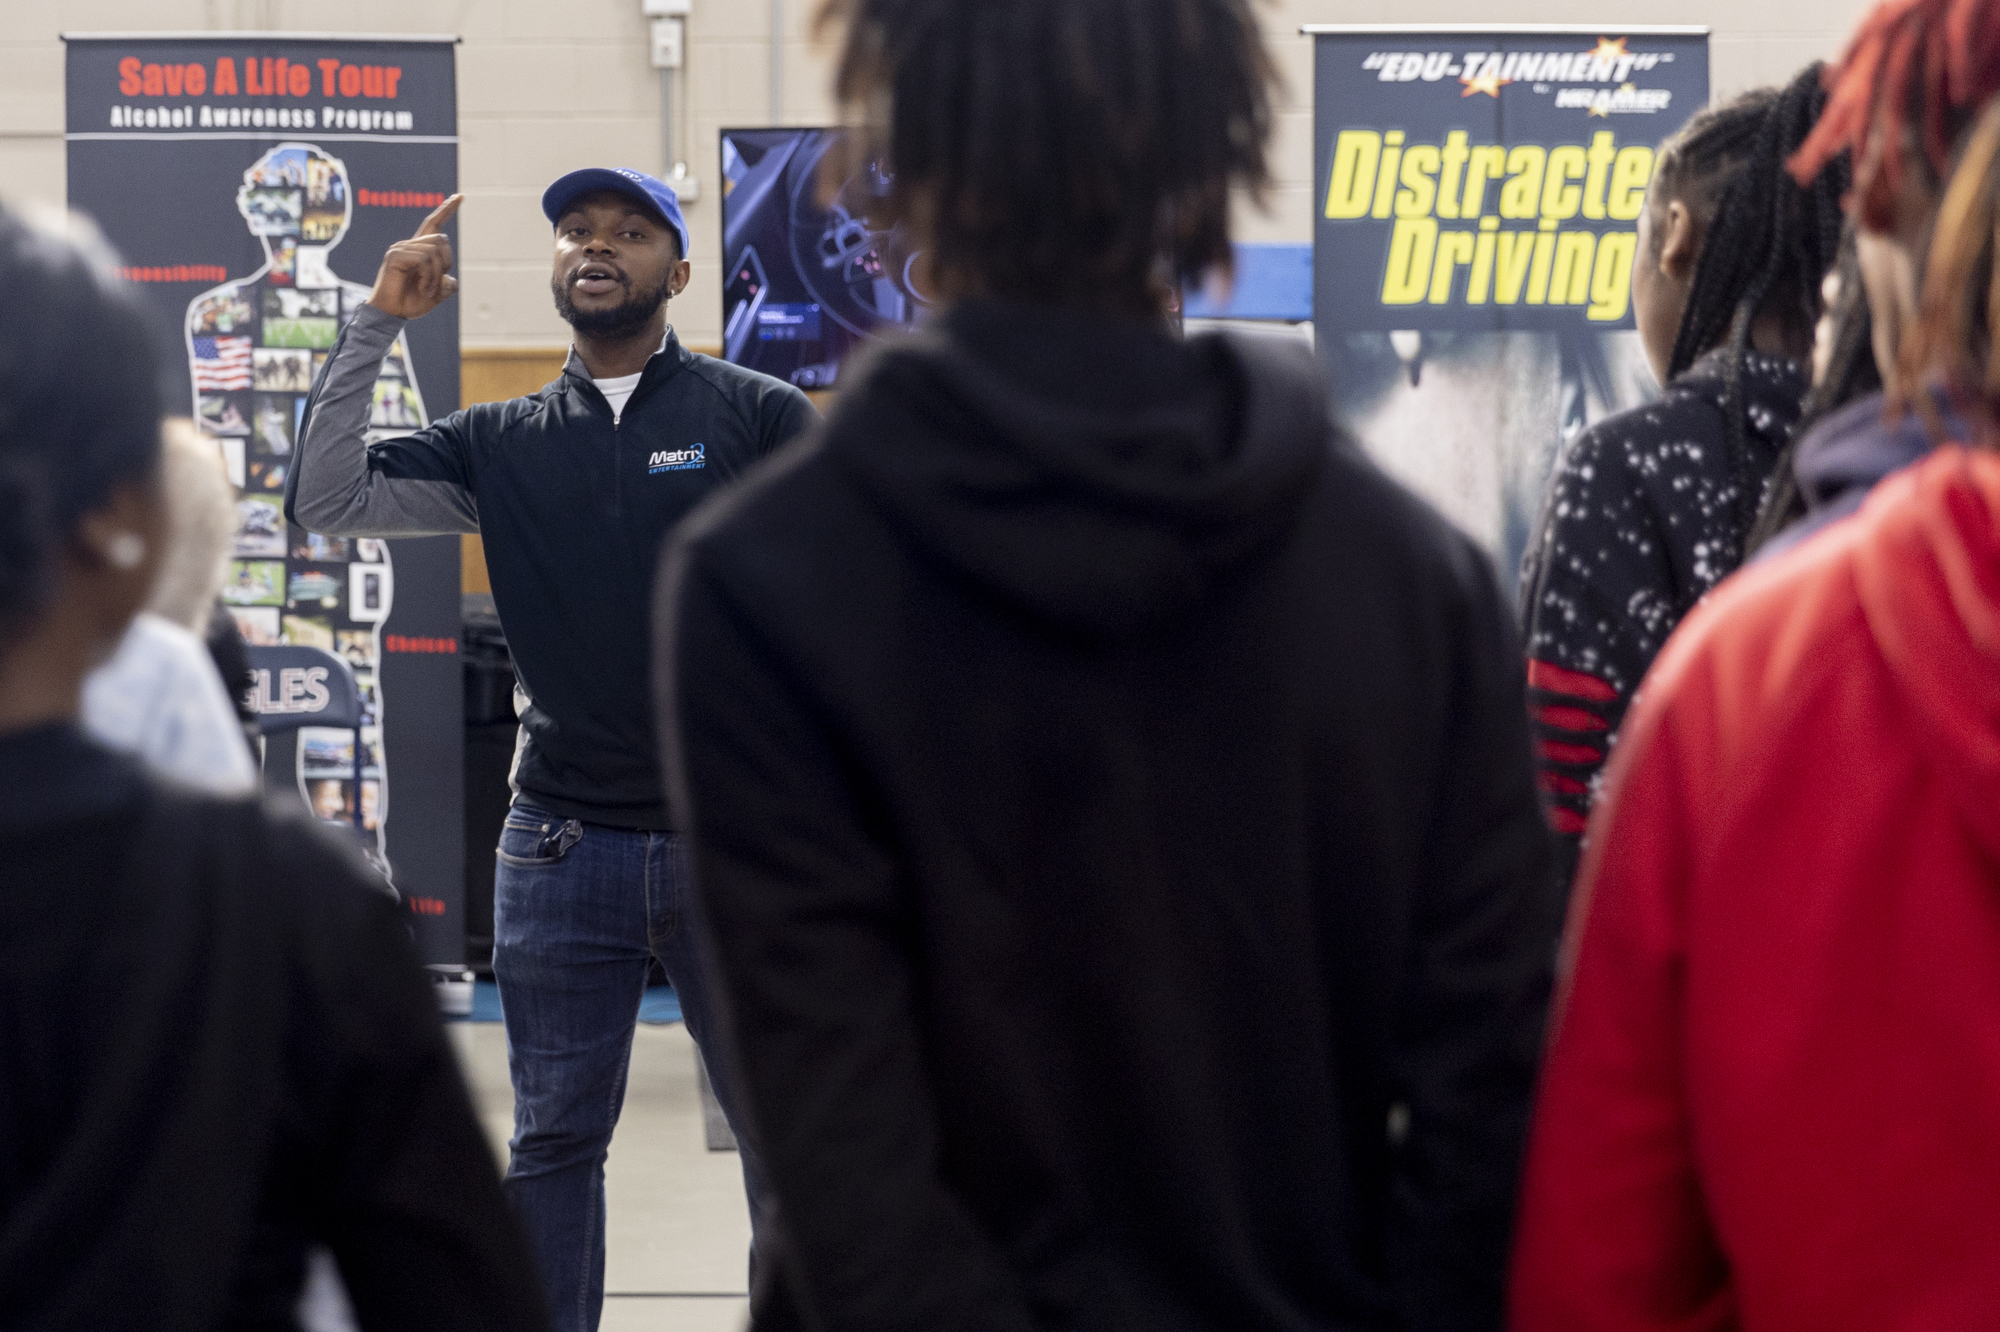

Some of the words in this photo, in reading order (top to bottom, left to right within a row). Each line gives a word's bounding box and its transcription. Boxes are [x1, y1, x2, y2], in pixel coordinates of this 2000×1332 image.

[118, 56, 207, 97] Save
[213, 56, 239, 96] A
[244, 56, 311, 97] Life
[317, 58, 402, 99] Tour
[109, 105, 193, 128] Alcohol
[199, 105, 316, 128] Awareness
[322, 106, 413, 131] Program
[1324, 130, 1663, 221] Distracte
[1380, 215, 1638, 321] Driving
[648, 449, 706, 466] Matrix
[648, 462, 706, 475] ENTERTAINMENT
